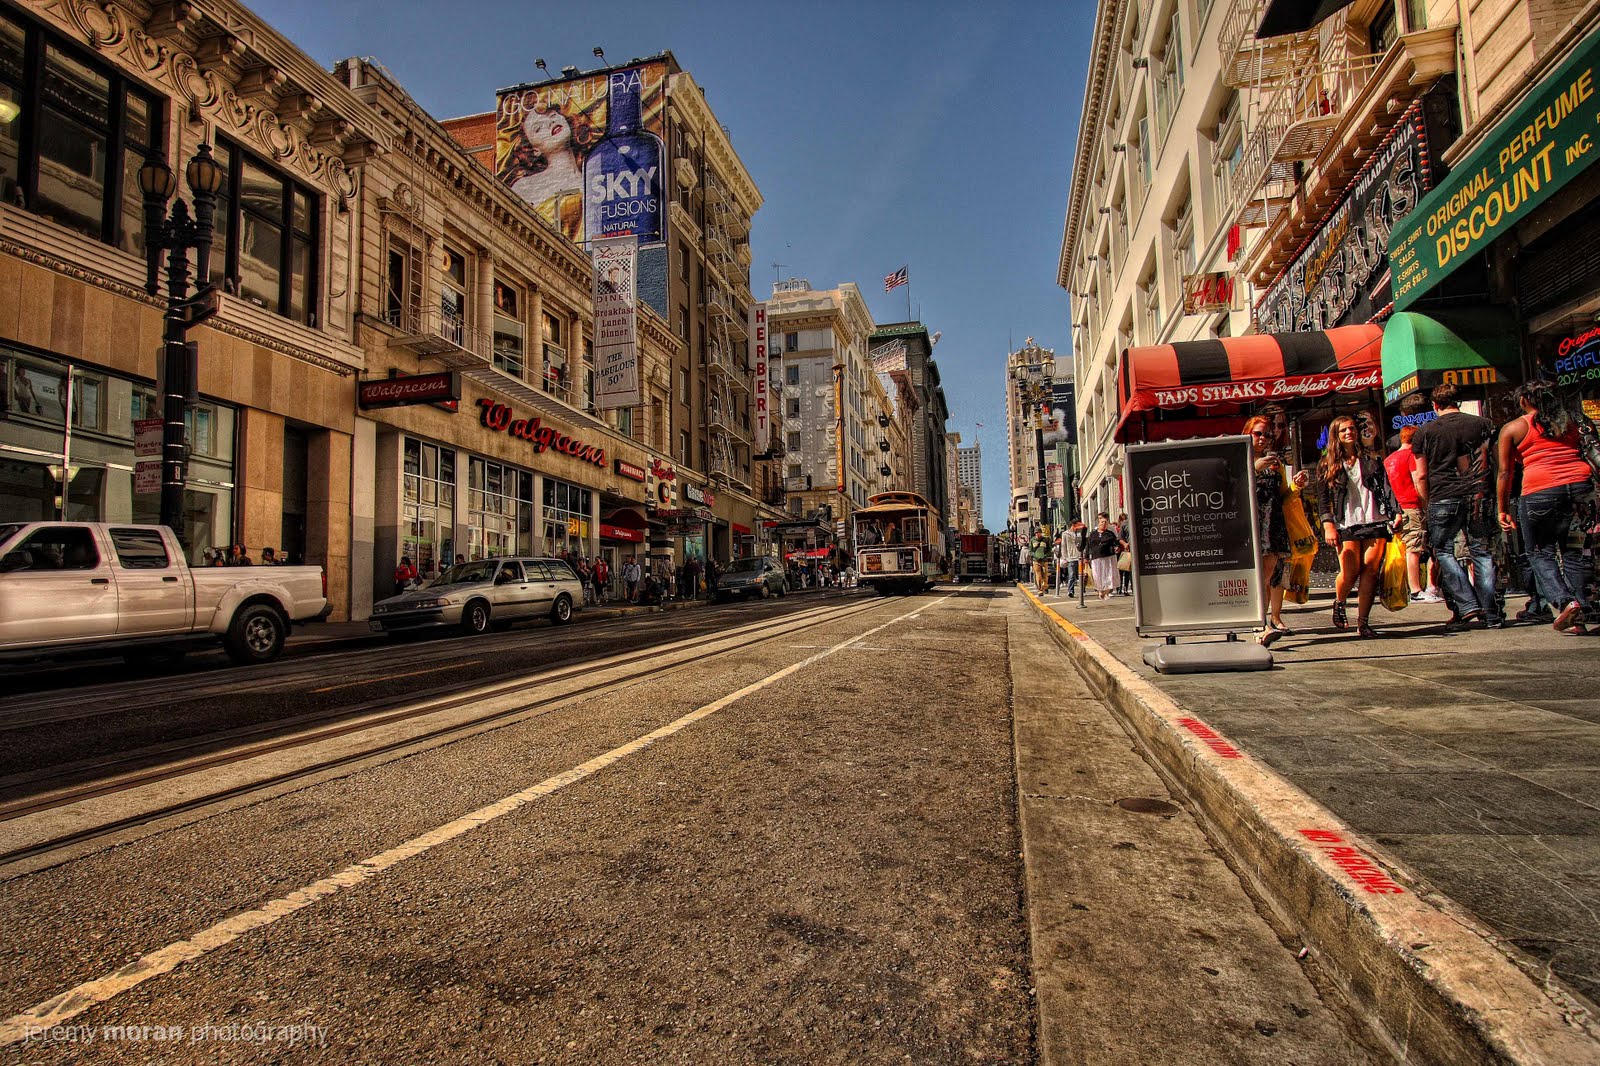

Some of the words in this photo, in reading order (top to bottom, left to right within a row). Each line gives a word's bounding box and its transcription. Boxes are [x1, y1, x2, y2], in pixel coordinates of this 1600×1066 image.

[502, 90, 540, 116] GO
[547, 68, 652, 109] NATURAL
[1355, 122, 1416, 201] PHILADELPHIA
[1426, 167, 1494, 237] ORIGINAL
[1498, 67, 1595, 175] PERFUME
[591, 166, 657, 204] SKYY
[1435, 140, 1556, 269] DISCOUNT
[1565, 133, 1594, 167] INC.
[603, 220, 639, 232] NATURAL
[1389, 240, 1407, 262] SWEAT
[1407, 225, 1423, 246] SHIRT
[1399, 247, 1416, 268] SALES
[1397, 260, 1420, 284] T-SHIRTS
[597, 292, 632, 303] DINER
[1191, 276, 1236, 307] H&M
[1400, 281, 1412, 297] FOR
[595, 307, 635, 318] Breakfast
[602, 317, 627, 327] Lunch
[601, 329, 628, 338] Dinner
[607, 352, 623, 363] THE
[596, 359, 635, 379] FABULOUS
[755, 309, 767, 430] HERBERT
[1442, 367, 1497, 385] ATM
[364, 379, 447, 398] Walgreens
[608, 373, 624, 386] 50's
[1155, 387, 1198, 406] TAD'S
[1202, 381, 1265, 402] STEAKS
[1271, 377, 1332, 397] Breakfast
[1335, 370, 1379, 390] Lunch
[1401, 375, 1418, 394] ATM
[478, 397, 609, 468] Walgreens
[1138, 470, 1192, 491] valet
[1140, 488, 1224, 515] parking
[1142, 513, 1181, 526] around
[1183, 512, 1201, 522] the
[1203, 511, 1238, 521] corner
[1142, 527, 1159, 537] 80
[1160, 525, 1181, 535] Ellis
[1183, 522, 1217, 534] Street
[1144, 552, 1160, 561] $30
[1167, 551, 1182, 560] $36
[1183, 548, 1225, 558] OVERSIZE
[1218, 587, 1248, 597] SQUARE
[1223, 579, 1248, 589] UNION
[1318, 846, 1405, 895] PARKING
